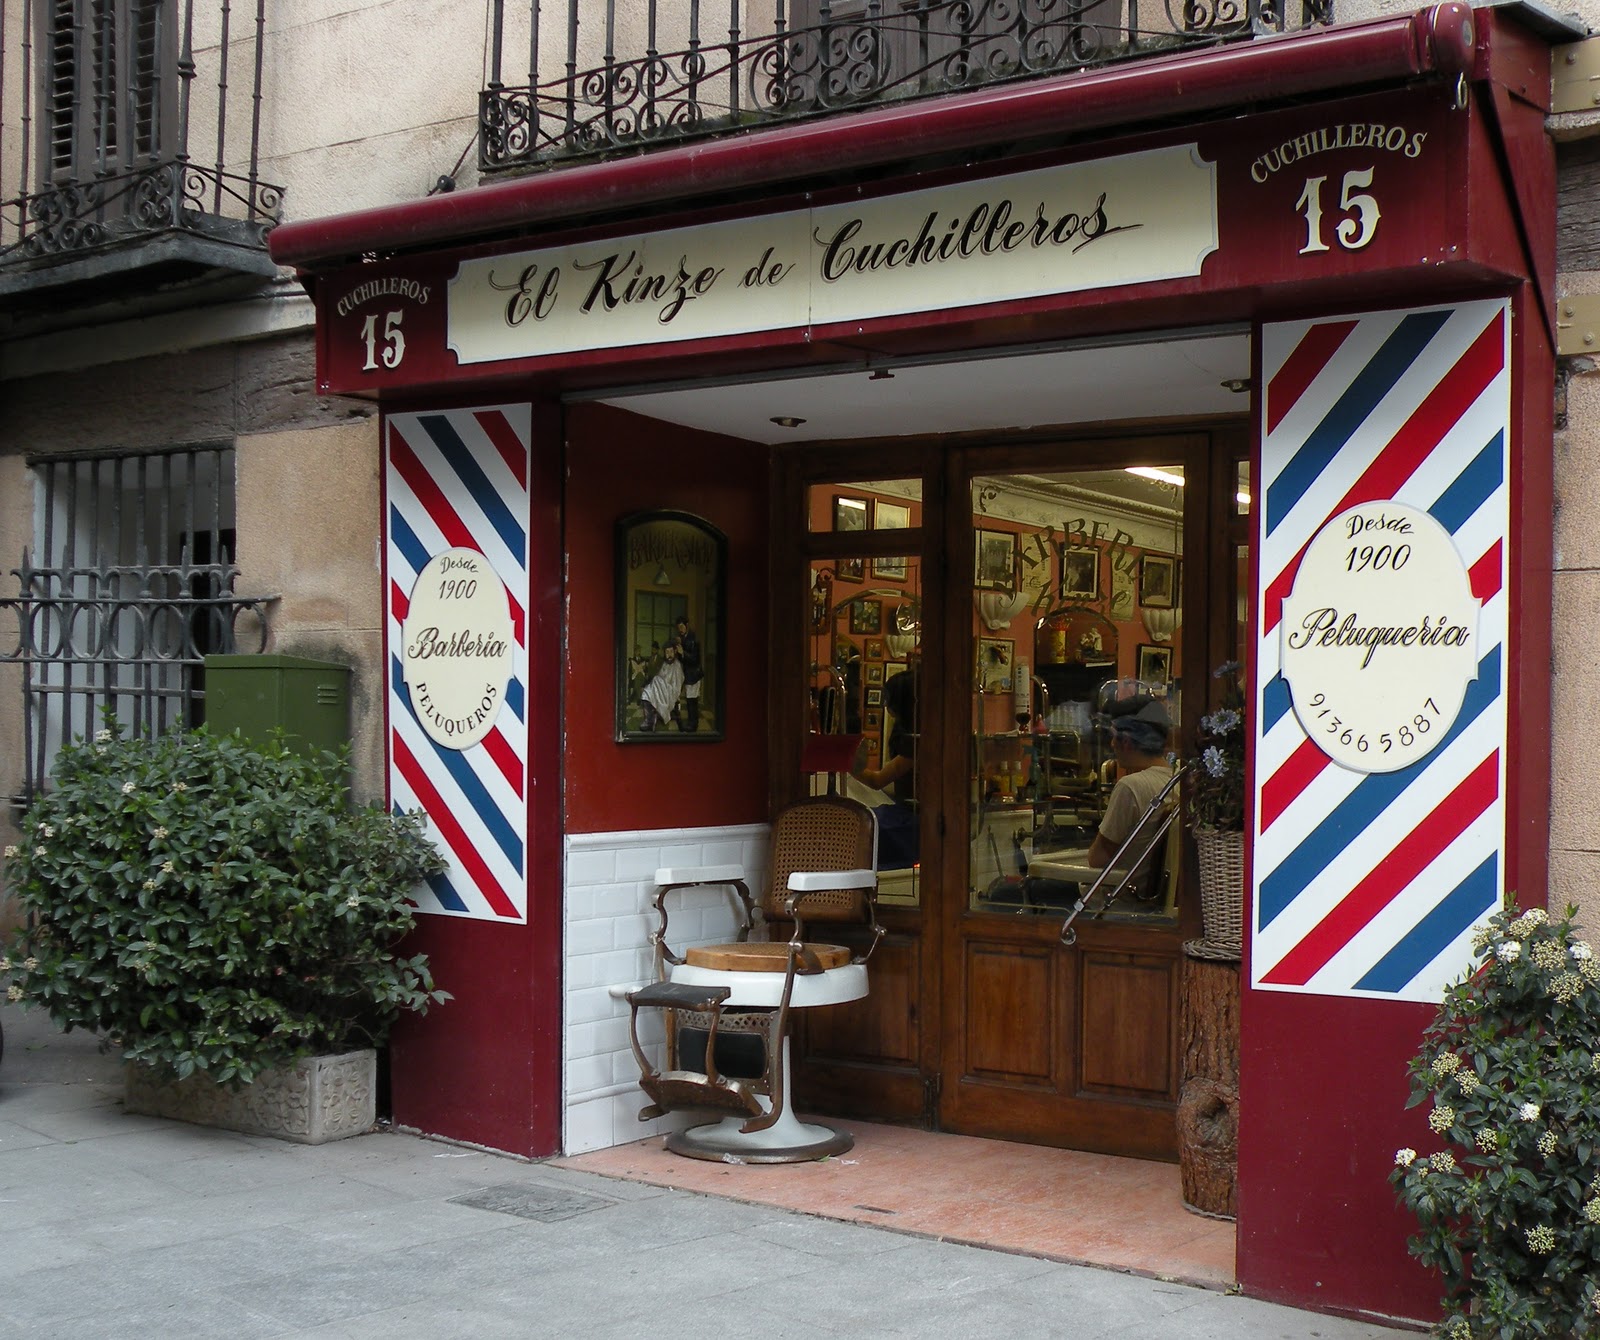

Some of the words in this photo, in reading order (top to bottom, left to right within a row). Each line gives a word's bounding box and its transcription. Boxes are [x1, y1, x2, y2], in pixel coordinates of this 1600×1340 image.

[1250, 123, 1428, 183] CUCHILLEROS
[1295, 165, 1381, 254] 15
[488, 263, 560, 328] El
[572, 249, 725, 326] Kinze
[737, 246, 796, 289] de
[813, 191, 1144, 283] Cuchilleros
[337, 277, 432, 316] CUCHILLEROS
[361, 308, 407, 371] 15
[1345, 513, 1415, 540] Desde
[439, 556, 479, 575] Desde
[1345, 544, 1411, 573] 1900
[439, 579, 478, 601] 1900
[415, 681, 497, 737] PELUQUEROS
